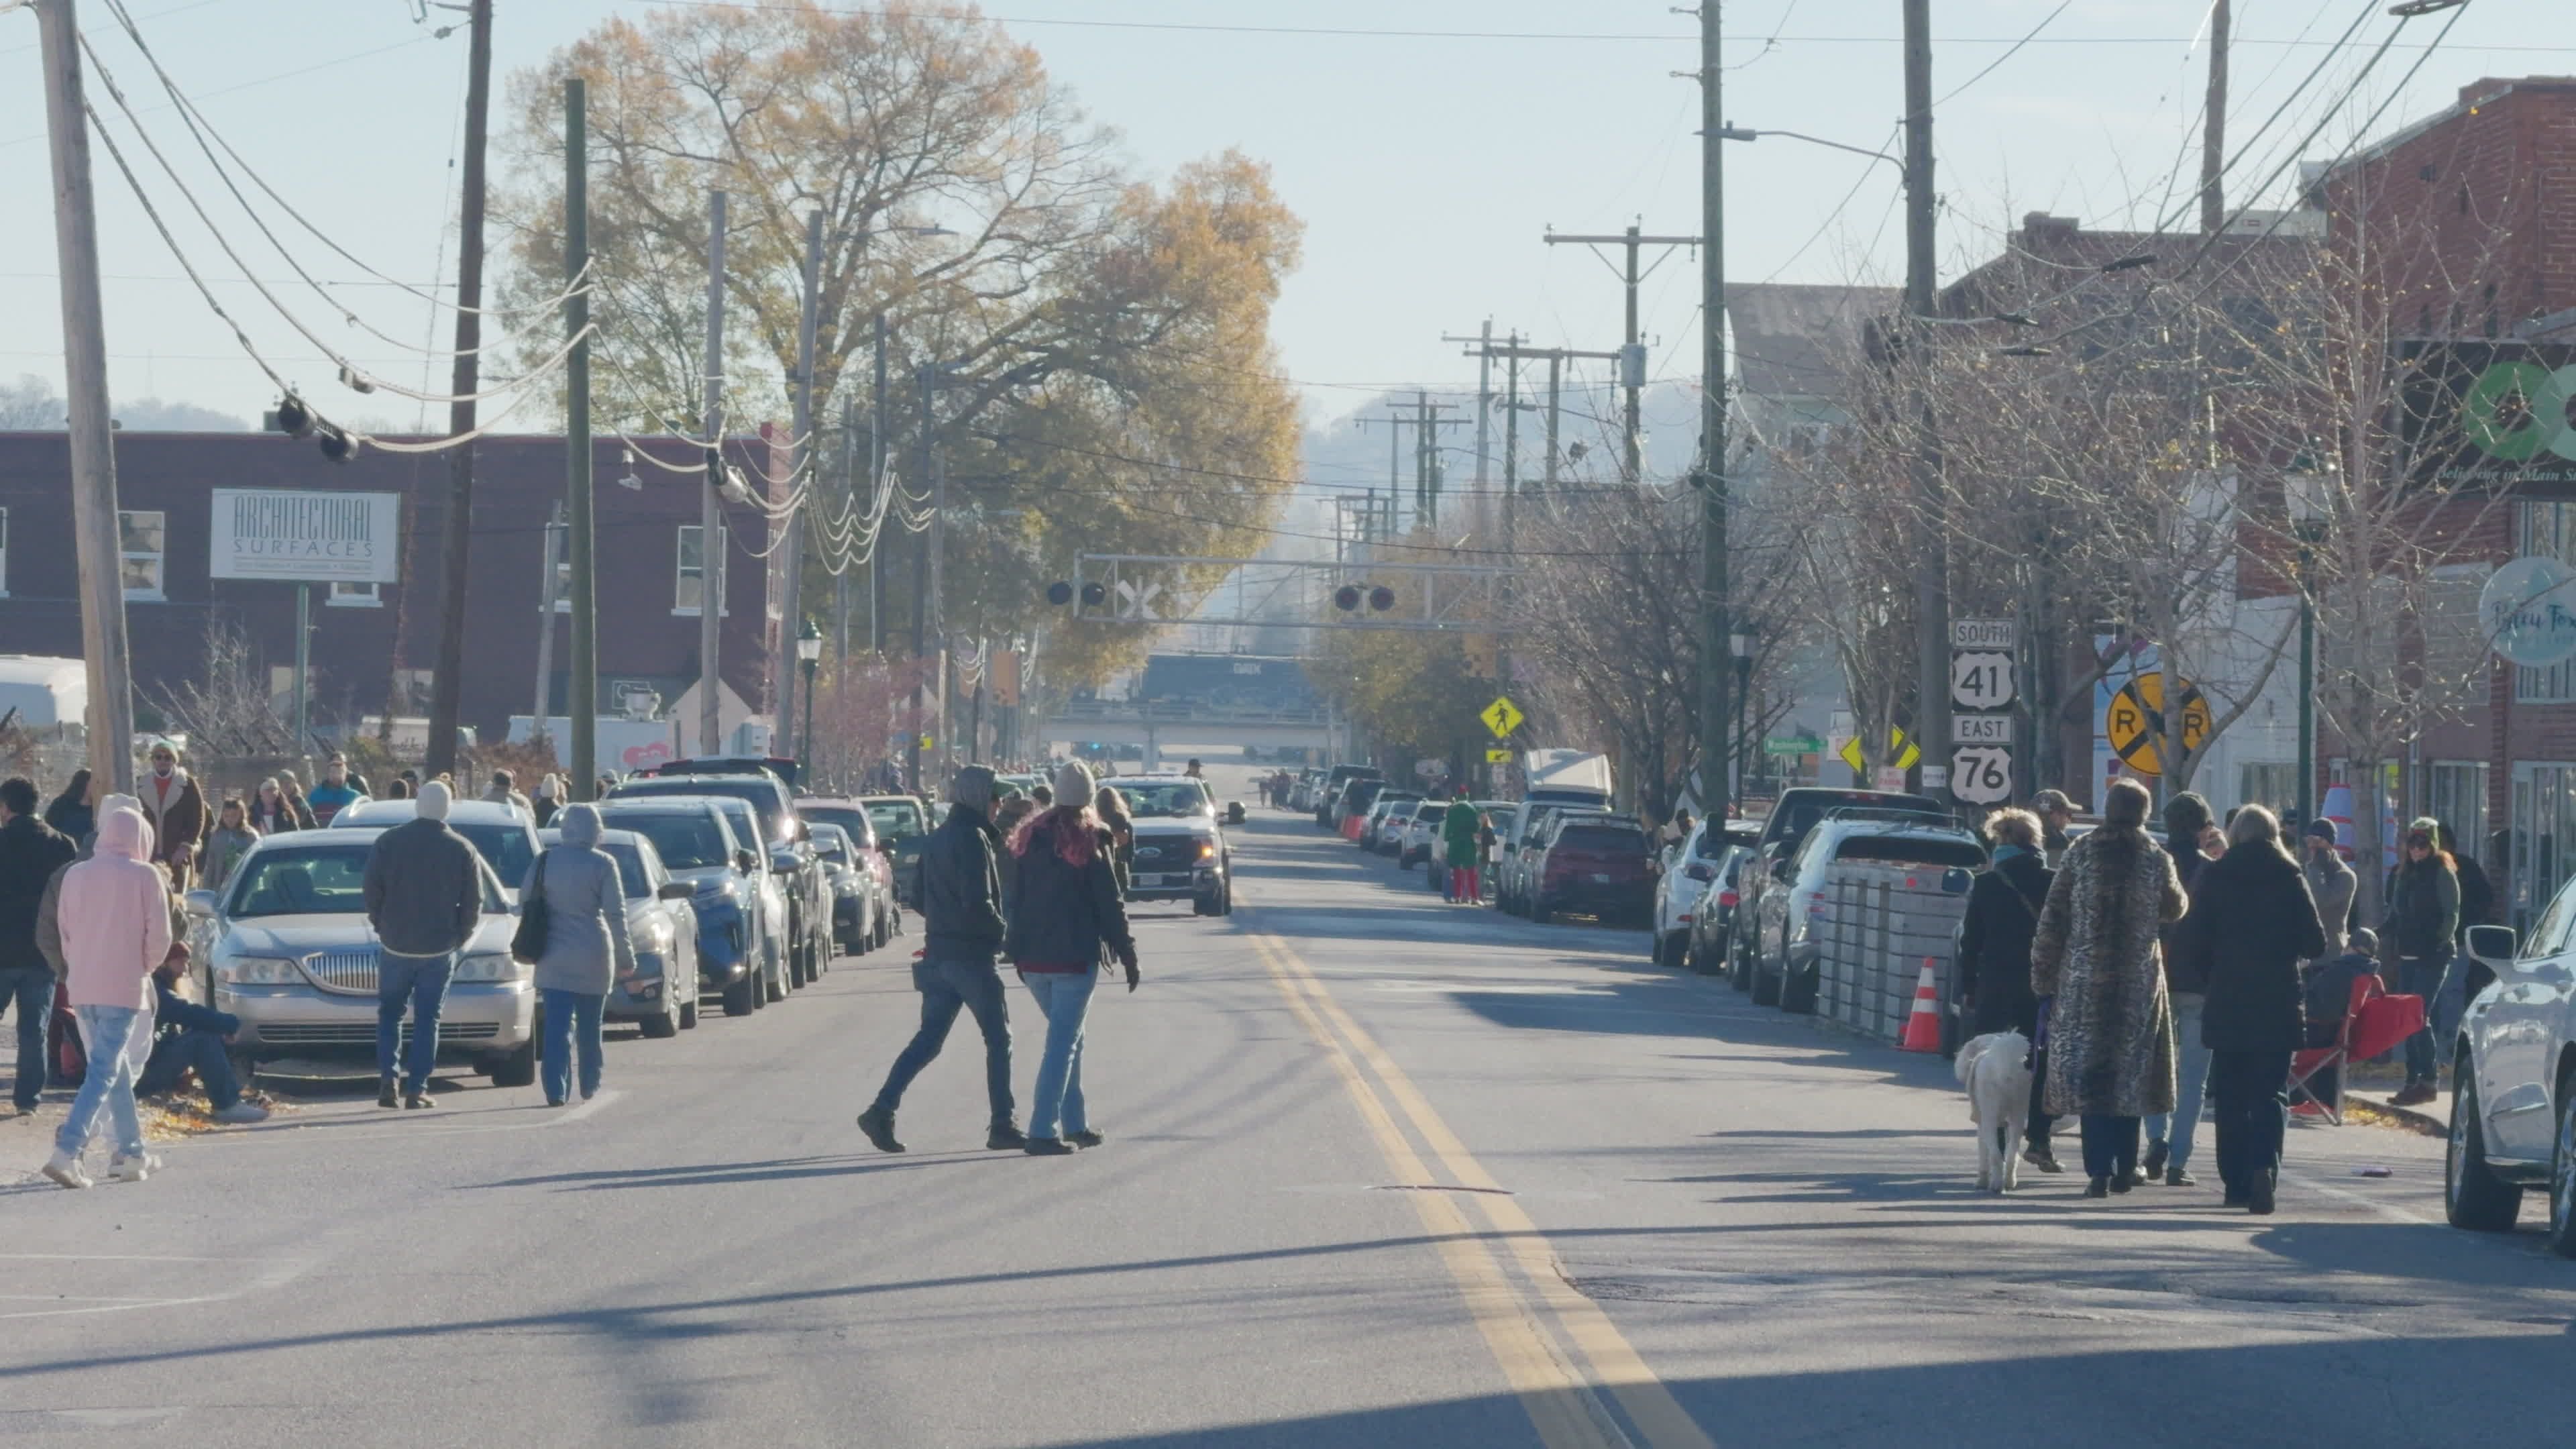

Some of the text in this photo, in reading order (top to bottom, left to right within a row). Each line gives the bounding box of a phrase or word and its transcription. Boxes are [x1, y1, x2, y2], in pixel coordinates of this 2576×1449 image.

[2436, 466, 2499, 484] Beliing
[2521, 468, 2560, 481] Main
[235, 496, 372, 540] ARCHITECTURAL
[234, 539, 373, 557] SURFACES
[1958, 625, 2009, 642] SOUTH
[1960, 665, 1997, 698] 41
[1962, 720, 2004, 738] EAST
[2116, 710, 2204, 738] R R
[1960, 756, 2004, 789] 76
